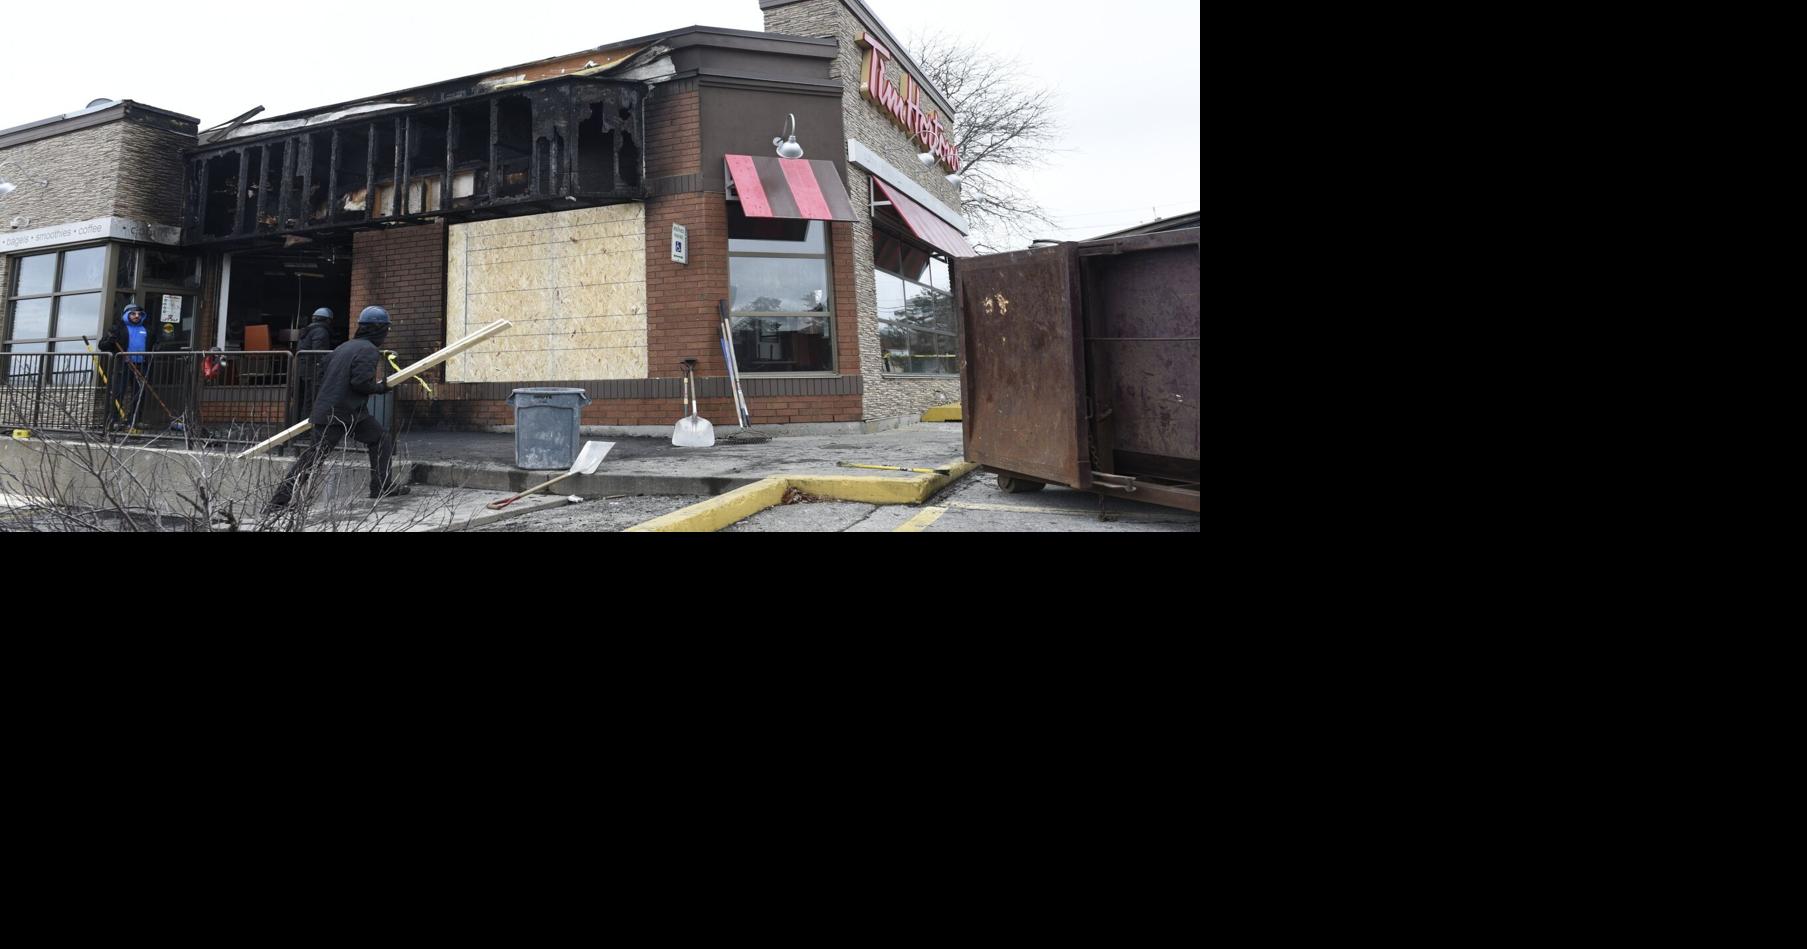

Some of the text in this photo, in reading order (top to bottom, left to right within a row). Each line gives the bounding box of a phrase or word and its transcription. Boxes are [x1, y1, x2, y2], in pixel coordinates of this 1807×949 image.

[856, 32, 961, 172] Tim Hortons
[6, 224, 103, 247] bagels smoothies coffee
